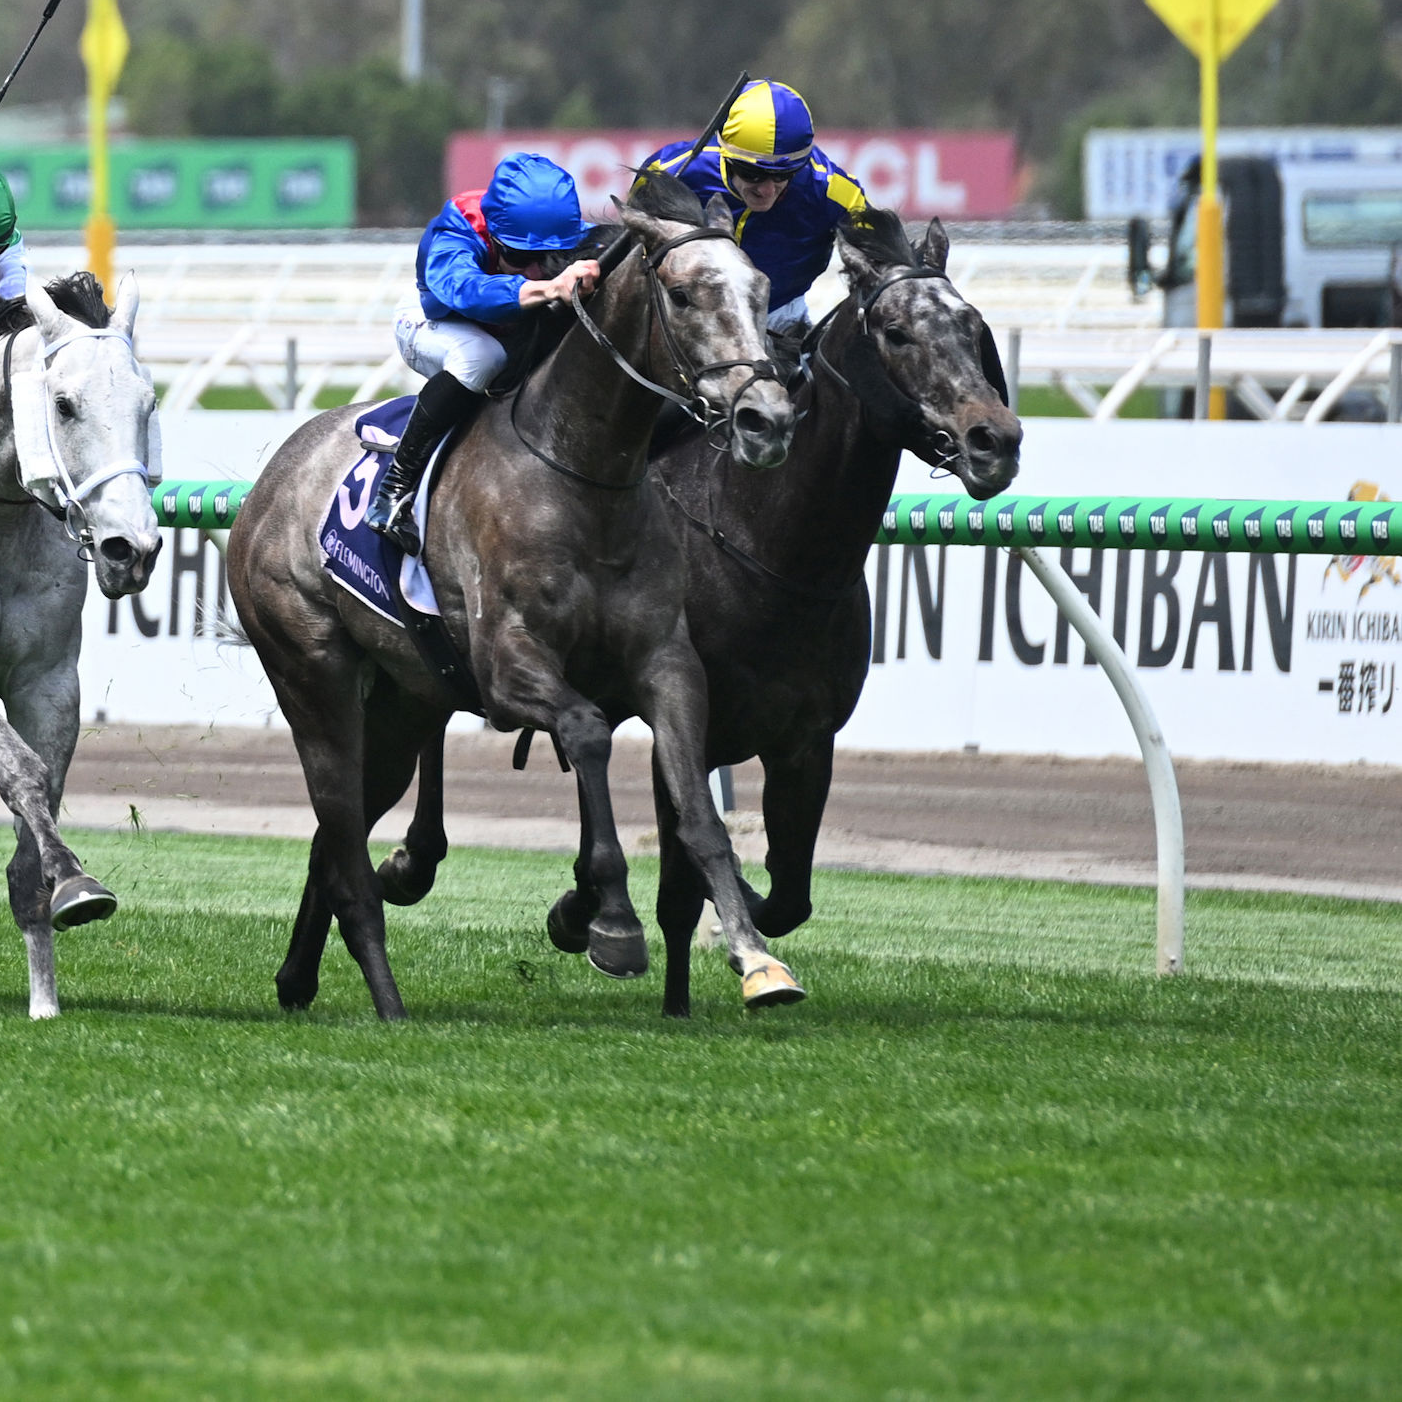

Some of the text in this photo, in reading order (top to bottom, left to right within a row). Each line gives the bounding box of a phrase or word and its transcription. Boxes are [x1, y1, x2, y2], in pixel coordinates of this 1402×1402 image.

[910, 510, 927, 529] TAB
[939, 511, 956, 529] TAB
[968, 511, 985, 530] TAB
[998, 512, 1015, 531] TAB
[1028, 514, 1045, 532] TAB
[1058, 514, 1075, 533] TAB
[1089, 515, 1106, 533] TAB
[1119, 515, 1137, 533] TAB
[1150, 516, 1167, 534] TAB
[1181, 516, 1197, 535] TAB
[1213, 519, 1231, 537] TAB
[1244, 519, 1261, 537] TAB
[1276, 519, 1293, 537] TAB
[1308, 519, 1326, 538] TAB
[1340, 519, 1357, 538] TAB
[1372, 520, 1389, 539] TAB
[1306, 610, 1402, 642] KIRIN ICHIBA
